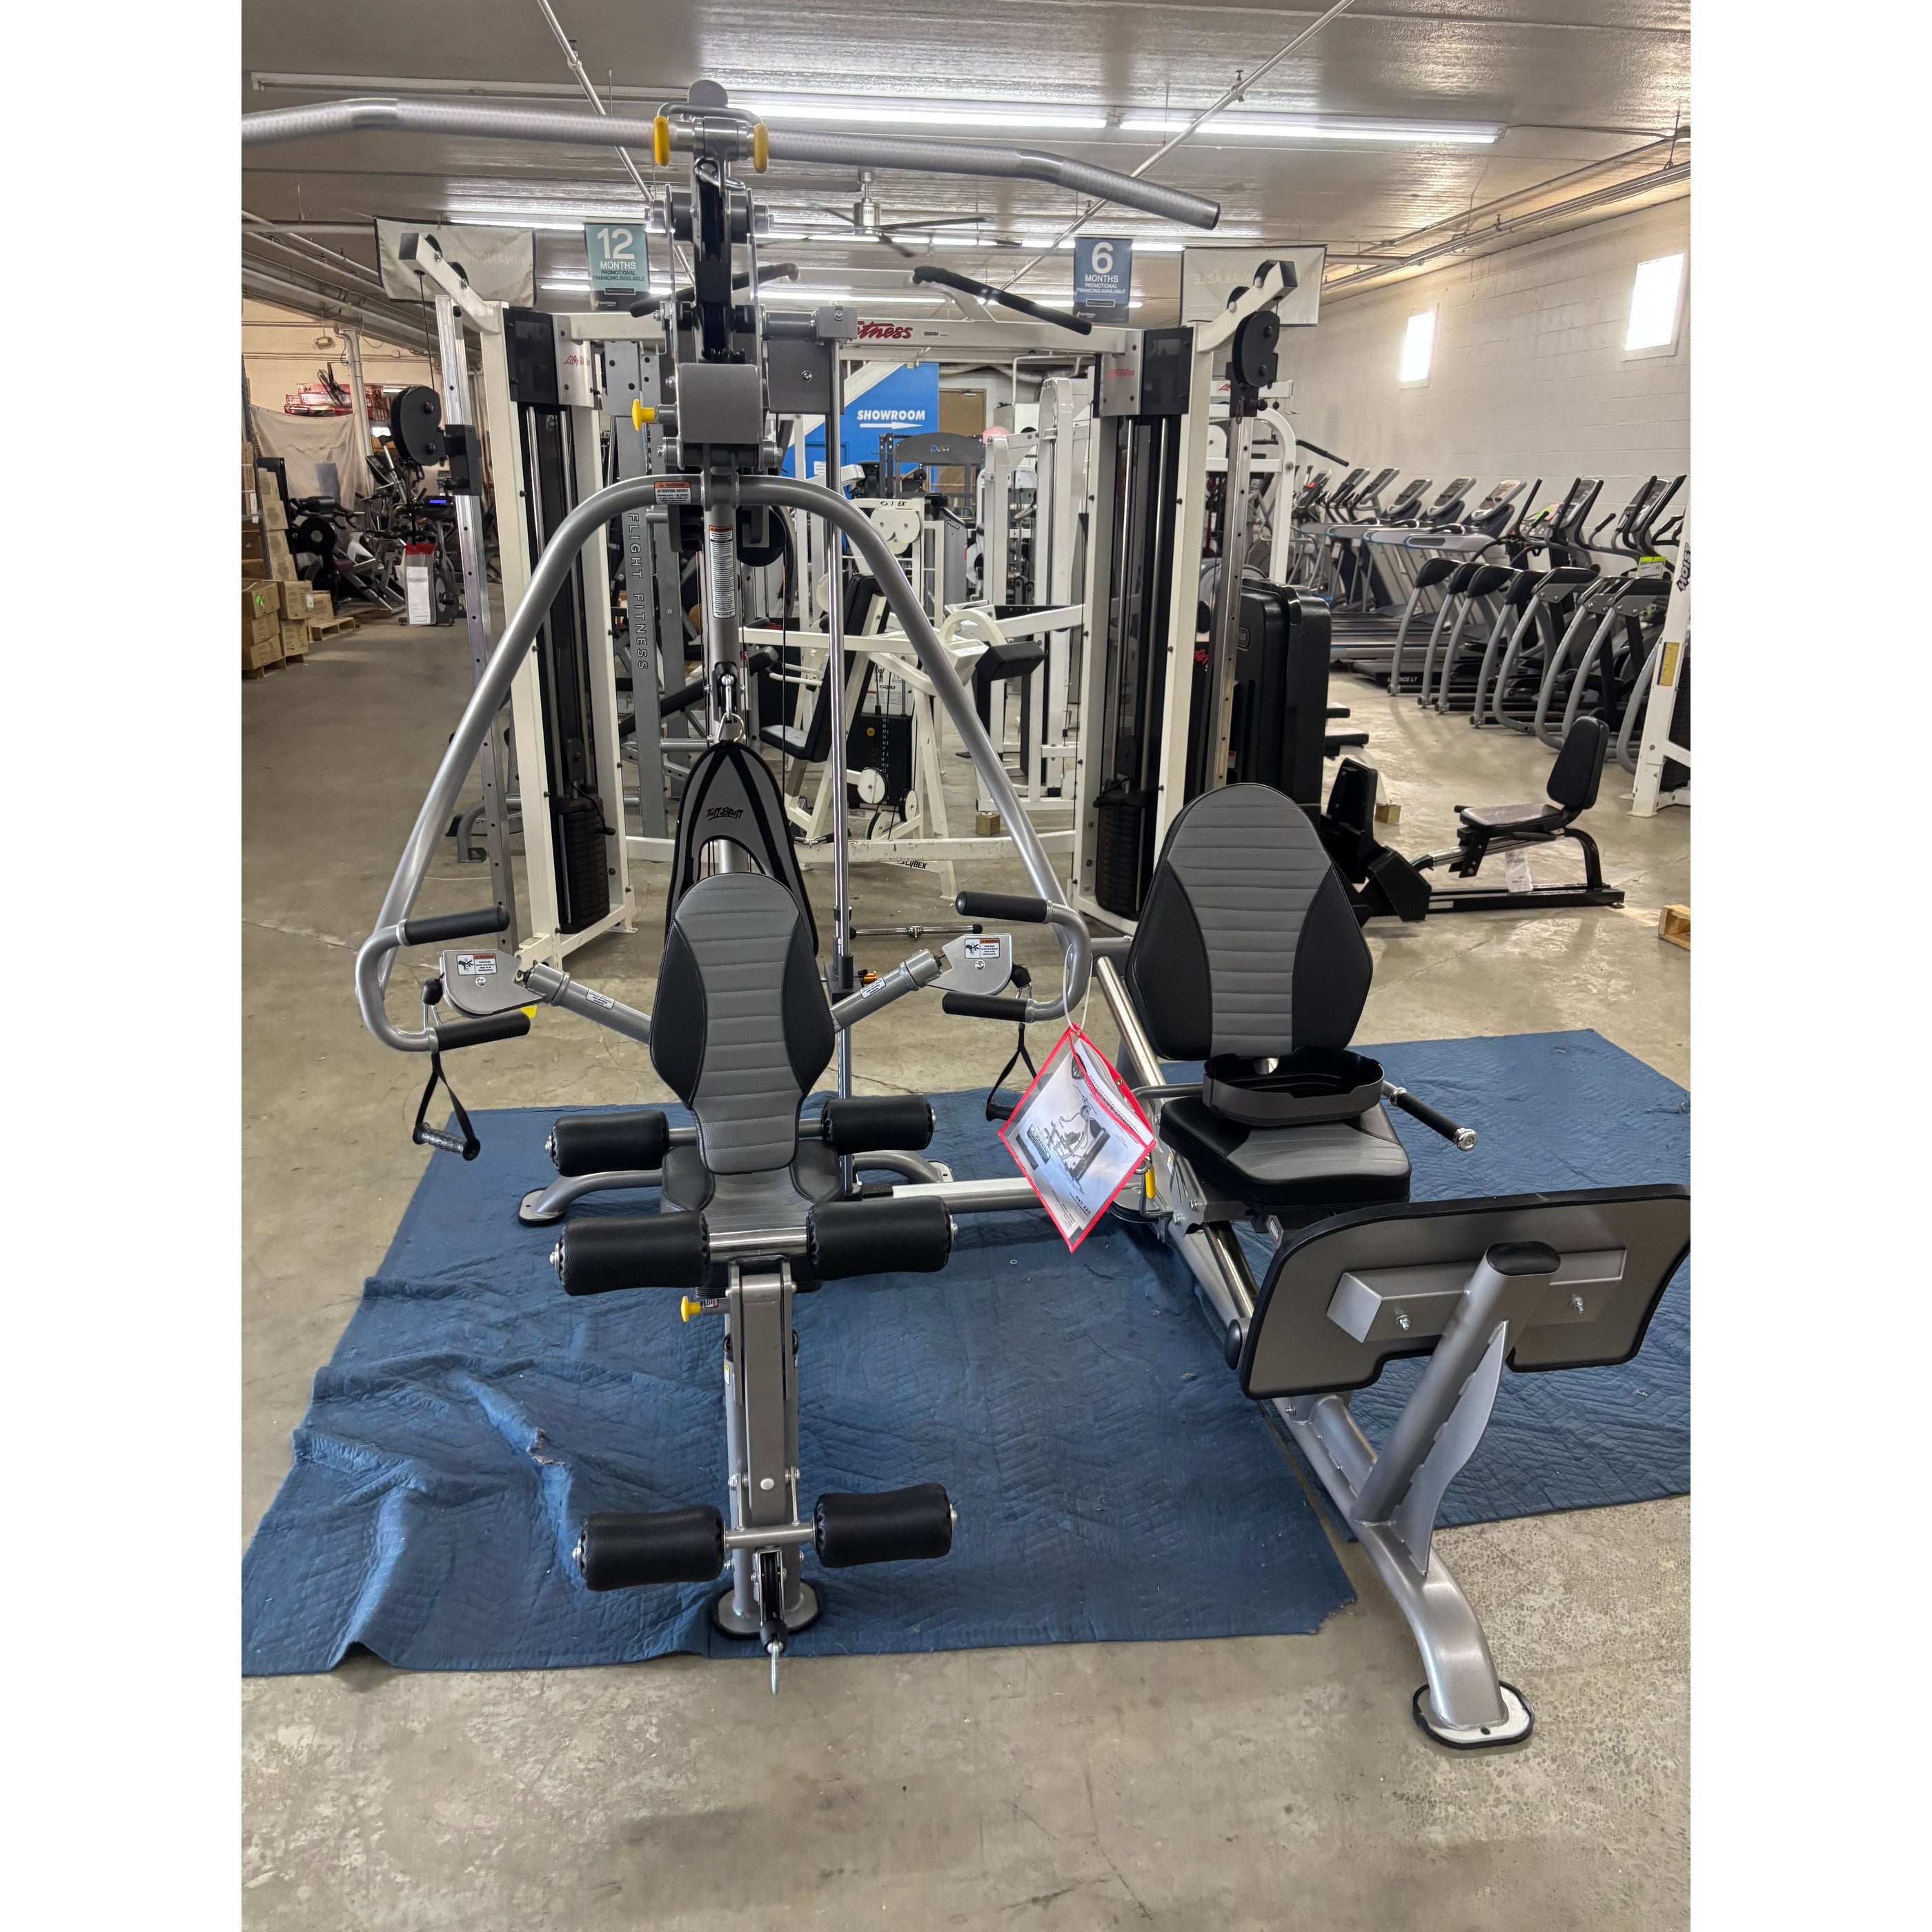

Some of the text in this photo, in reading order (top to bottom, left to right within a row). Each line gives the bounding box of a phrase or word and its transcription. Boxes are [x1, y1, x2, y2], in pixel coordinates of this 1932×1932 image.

[597, 228, 635, 259] 12
[600, 261, 636, 270] MONTHS
[1092, 241, 1114, 274] 6
[1085, 275, 1118, 283] MONTHS
[857, 410, 925, 420] SHOWROOM
[629, 513, 643, 579] FLIGHT
[633, 593, 649, 669] FITNESS
[1075, 1195, 1091, 1215] AXT-225
